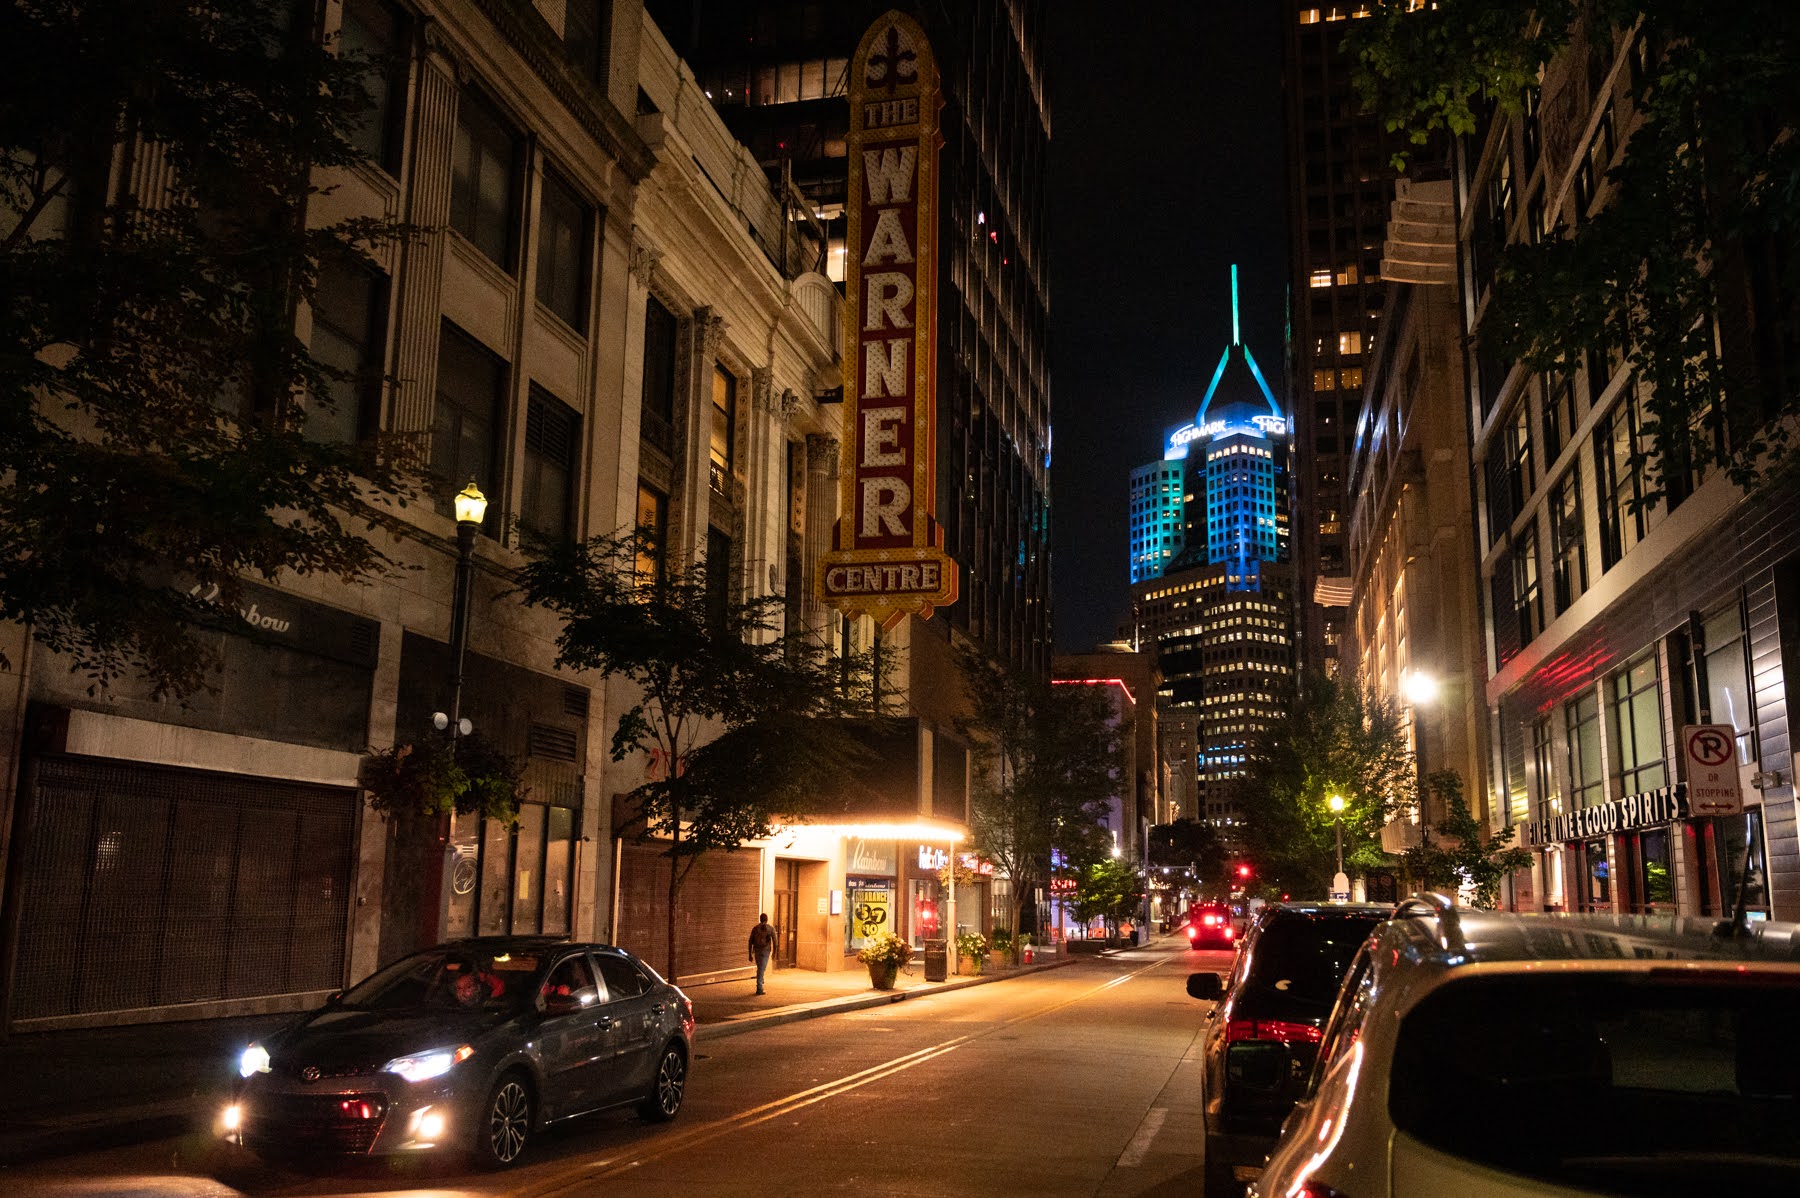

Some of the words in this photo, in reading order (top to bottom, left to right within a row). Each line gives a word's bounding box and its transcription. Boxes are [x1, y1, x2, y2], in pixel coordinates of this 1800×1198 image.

[864, 100, 918, 127] THE
[860, 145, 920, 538] WARNER
[1170, 419, 1227, 447] HIGHMARK
[826, 563, 940, 594] CENTRE
[1708, 773, 1719, 782] OR
[1696, 788, 1735, 798] STOPPING
[1550, 811, 1575, 842] WINE
[1585, 801, 1617, 834] GOOD
[1621, 784, 1680, 828] SPIRITS
[852, 840, 888, 871] Rainbow
